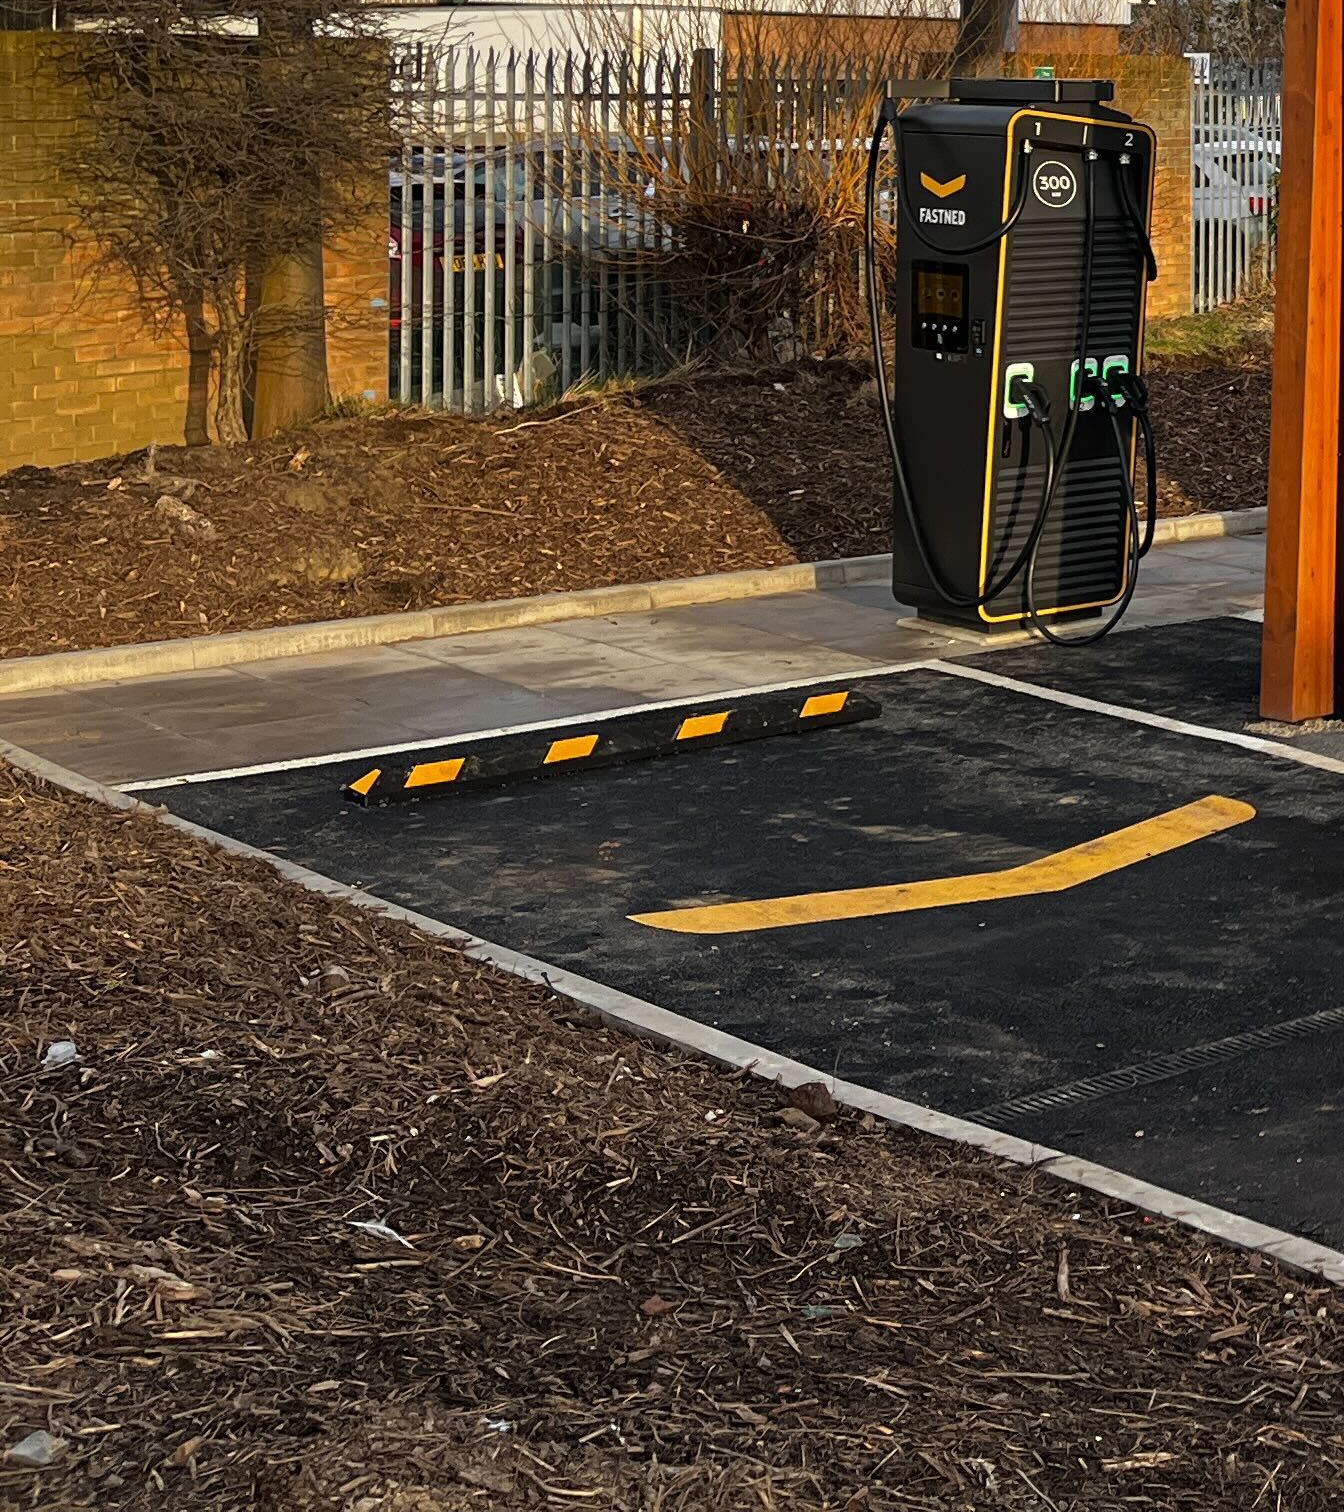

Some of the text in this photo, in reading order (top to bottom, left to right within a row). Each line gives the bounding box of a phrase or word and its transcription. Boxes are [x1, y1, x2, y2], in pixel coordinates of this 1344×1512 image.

[1034, 122, 1041, 136] 1
[1124, 132, 1134, 147] 2
[1039, 175, 1071, 190] 300
[919, 207, 966, 226] FASTNED
